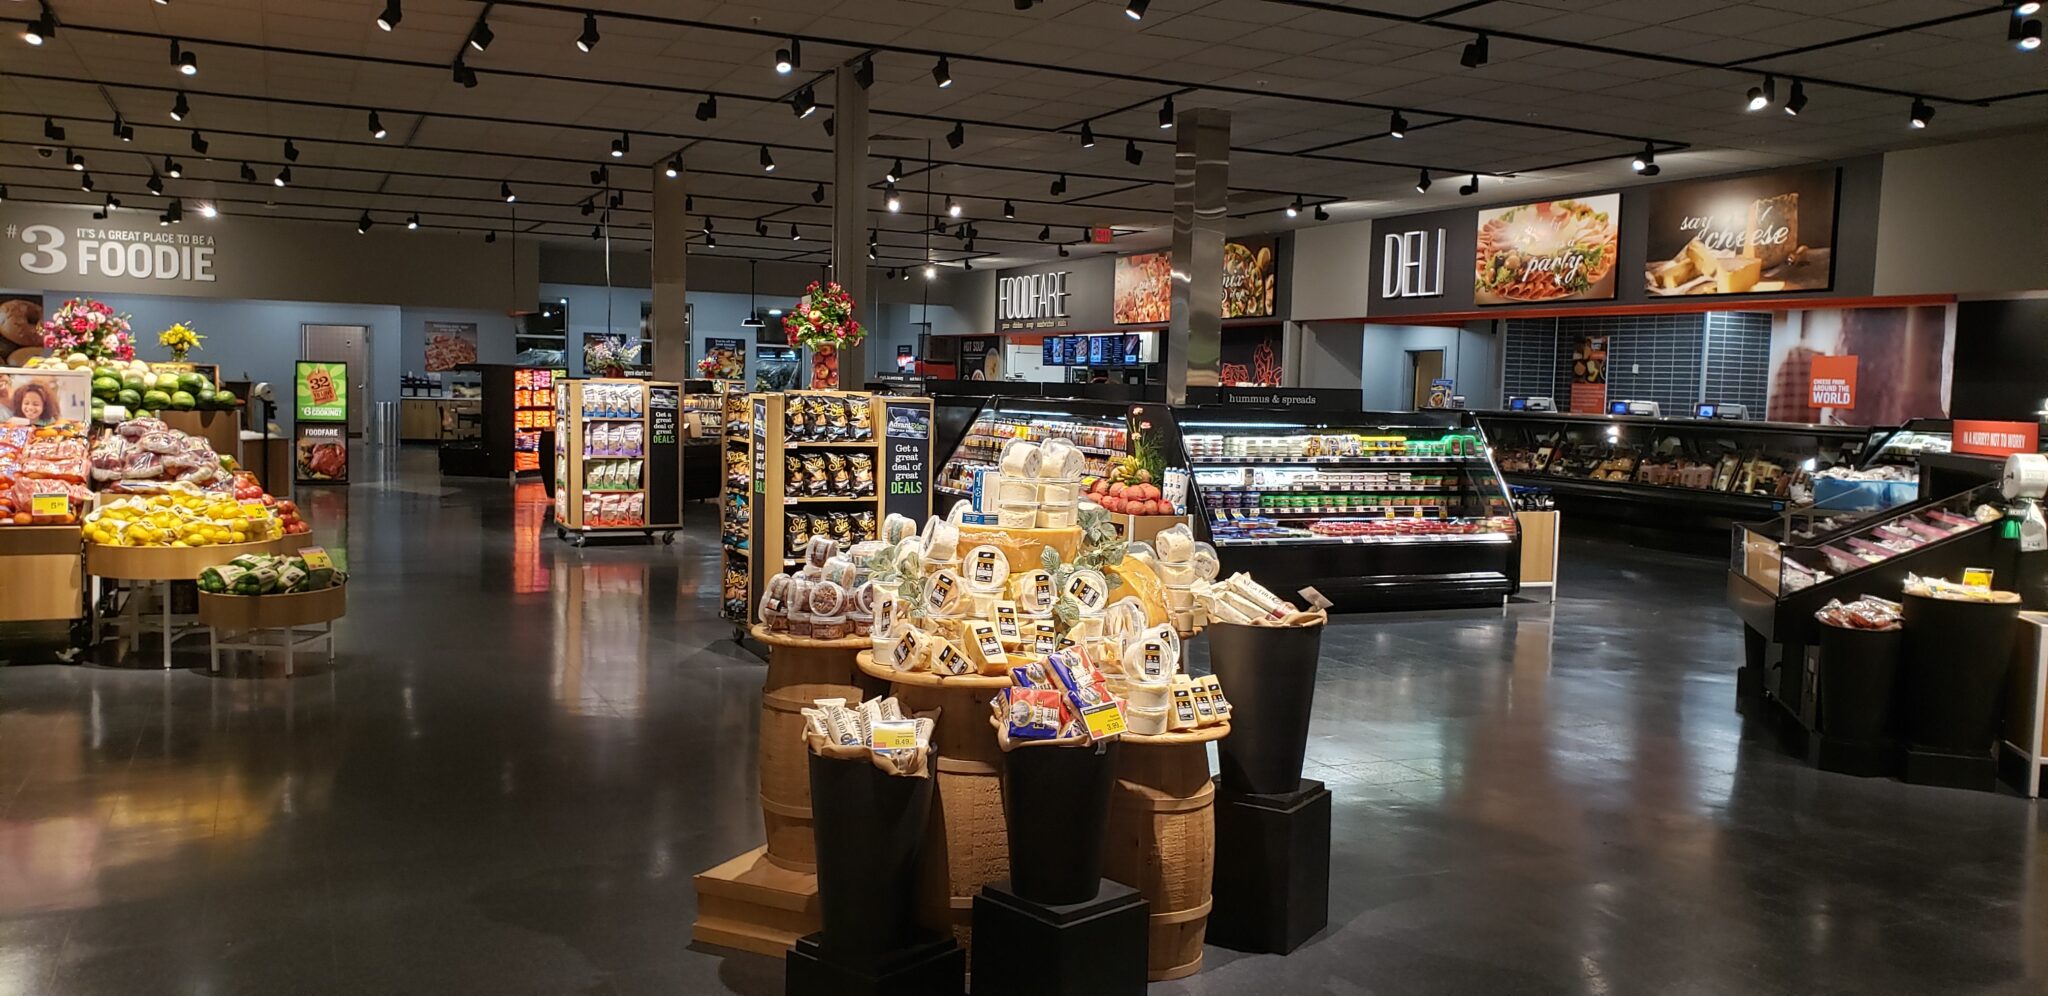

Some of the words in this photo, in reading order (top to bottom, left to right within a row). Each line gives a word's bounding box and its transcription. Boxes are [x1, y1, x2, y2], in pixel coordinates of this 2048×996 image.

[1680, 215, 1712, 240] say
[77, 228, 95, 239] IT'S
[98, 229, 106, 239] A
[108, 230, 141, 242] GREAT
[143, 231, 174, 244] PLACE
[177, 233, 190, 244] TO
[192, 235, 205, 246] BE
[207, 236, 215, 246] A
[1704, 224, 1789, 249] cheese
[78, 240, 216, 282] FOODIE
[1382, 228, 1447, 299] DELI
[1521, 249, 1584, 283] party
[999, 271, 1067, 320] FOODFARE
[973, 341, 985, 352] SOUP
[309, 376, 331, 390] 32
[1838, 385, 1850, 393] THE
[1228, 393, 1270, 404] hummus
[1271, 394, 1280, 404] &
[1281, 394, 1316, 406] spreads
[1813, 391, 1851, 405] WORLD
[304, 428, 339, 437] FOODFARE
[653, 435, 675, 444] DEALS
[1990, 432, 2000, 447] NOT
[2000, 433, 2007, 448] TO
[2007, 433, 2026, 449] WORRY
[895, 444, 911, 453] Get
[912, 445, 919, 453] a
[895, 453, 919, 463] great
[891, 462, 910, 471] deal
[912, 462, 922, 471] of
[895, 471, 919, 481] great
[891, 481, 923, 494] DEALS
